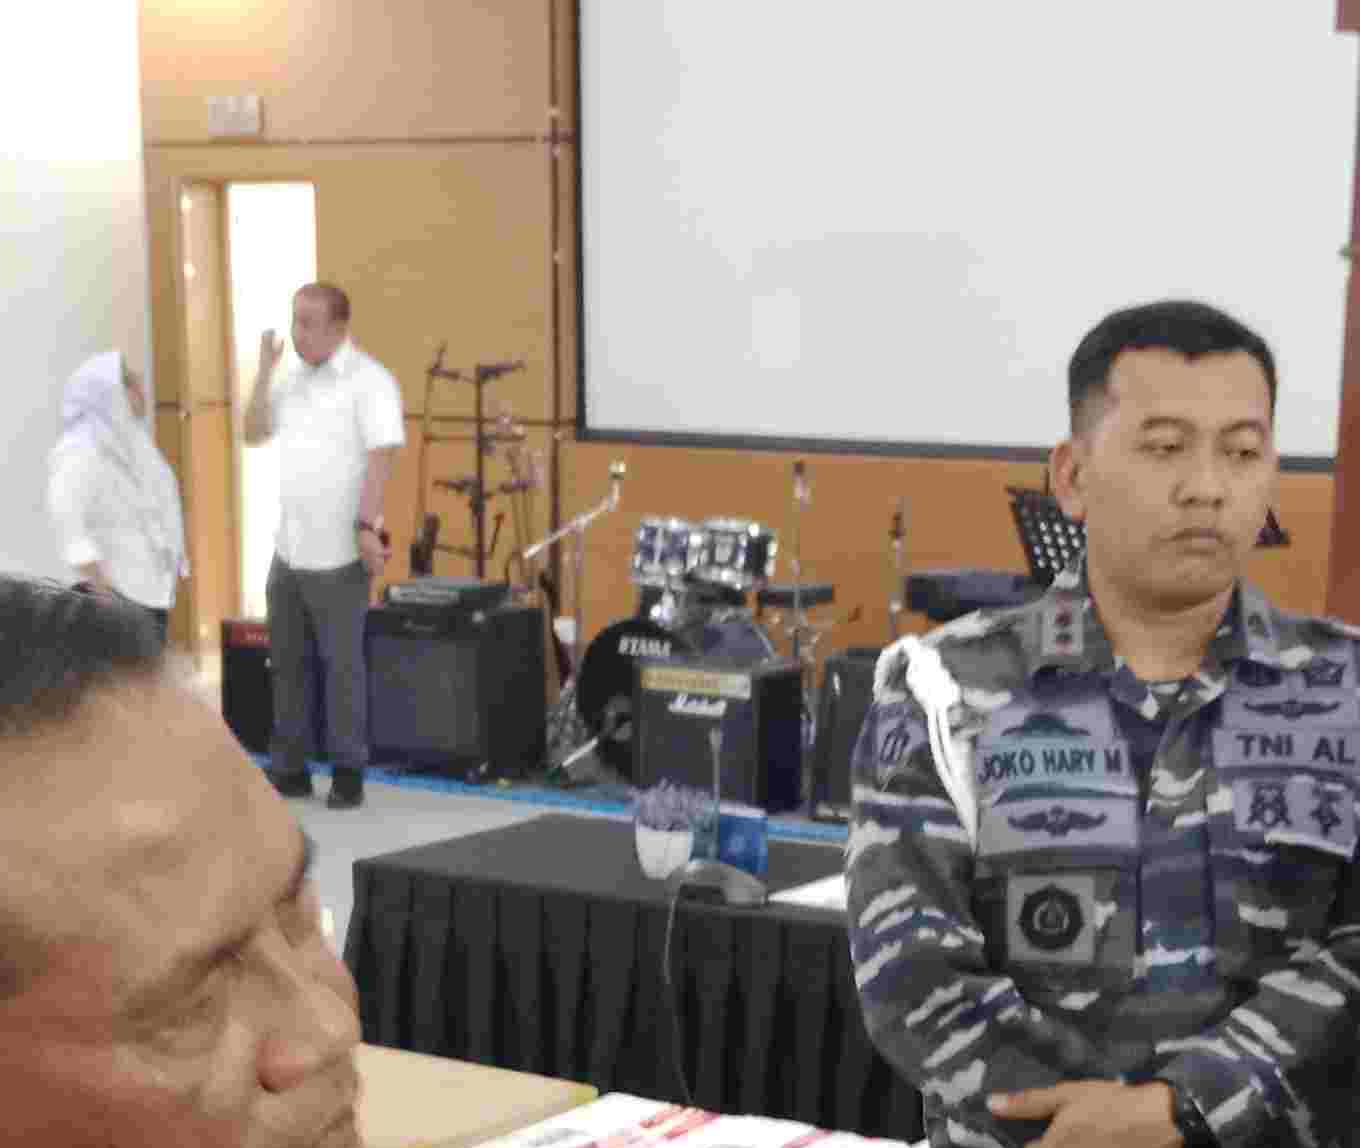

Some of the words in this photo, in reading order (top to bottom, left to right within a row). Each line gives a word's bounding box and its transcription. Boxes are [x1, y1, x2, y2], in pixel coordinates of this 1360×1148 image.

[977, 750, 1035, 784] JOKO
[1042, 748, 1095, 774] HARY
[1236, 733, 1294, 758] TNI
[1311, 736, 1356, 765] AL
